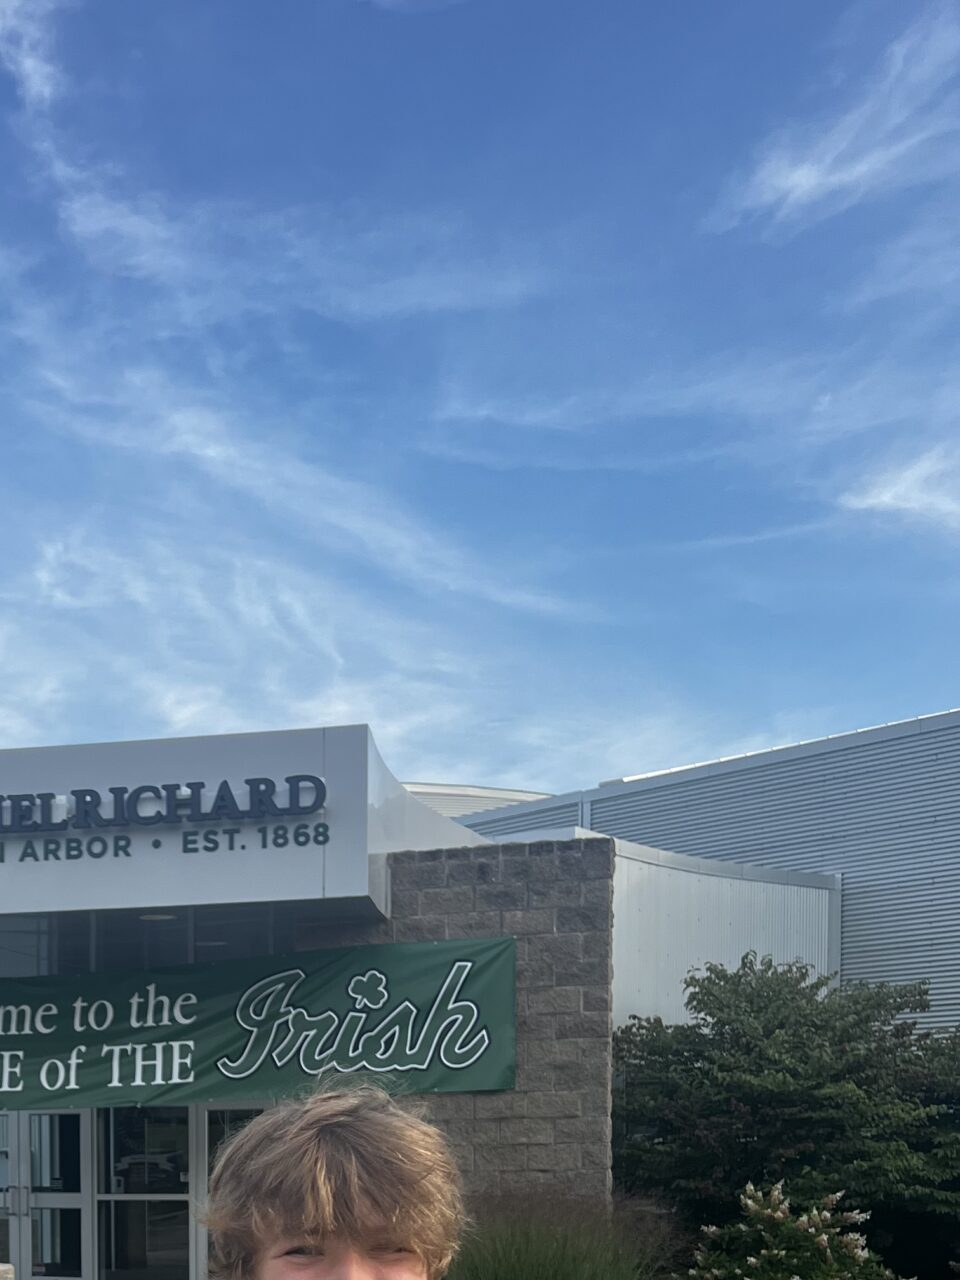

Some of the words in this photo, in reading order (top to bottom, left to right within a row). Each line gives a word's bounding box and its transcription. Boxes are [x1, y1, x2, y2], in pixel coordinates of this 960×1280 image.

[70, 774, 328, 829] RICHARD
[18, 836, 132, 862] ARBOR
[182, 829, 246, 854] EST.
[257, 823, 330, 849] 1868
[72, 997, 114, 1032] to
[128, 983, 198, 1029] the
[216, 961, 489, 1078] Irish
[40, 1045, 86, 1091] of
[101, 1040, 195, 1088] THE
